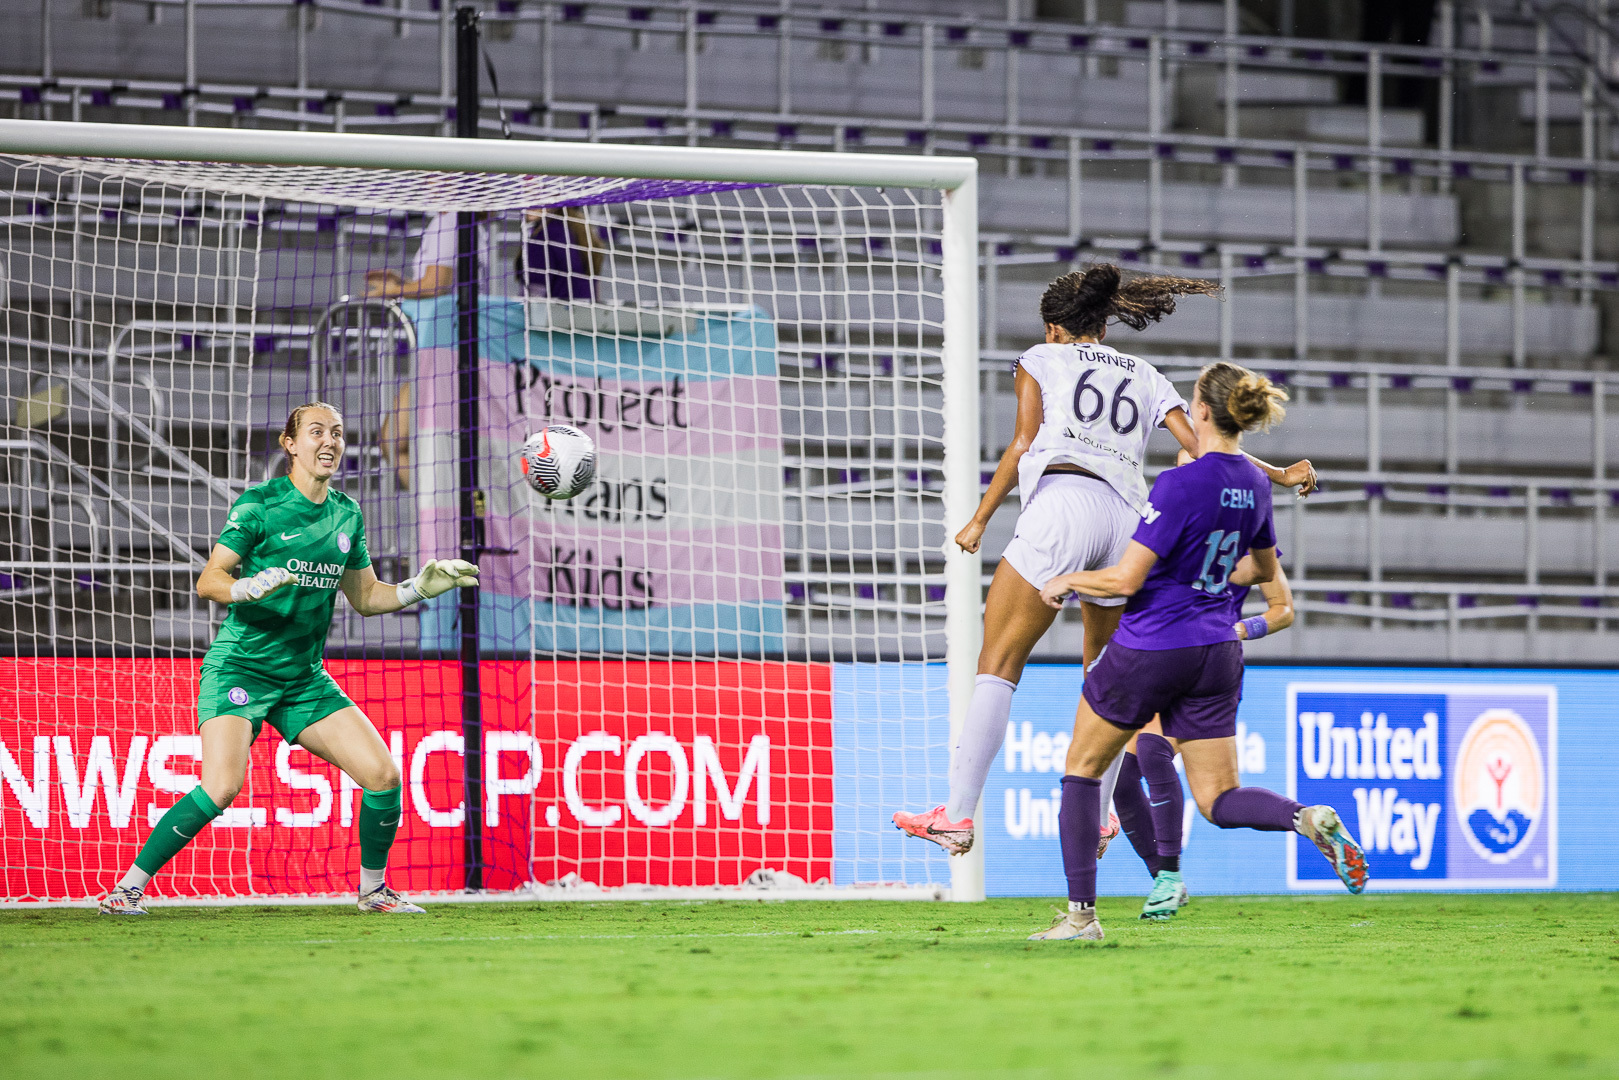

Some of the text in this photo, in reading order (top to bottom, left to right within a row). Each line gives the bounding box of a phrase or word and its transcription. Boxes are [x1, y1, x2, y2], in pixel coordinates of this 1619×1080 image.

[511, 358, 690, 431] Protect
[1076, 349, 1136, 373] TURNER
[1073, 367, 1139, 435] 66
[1220, 488, 1255, 509] CELIA
[286, 558, 345, 576] ORLANDO
[292, 573, 339, 589] HEALTH
[545, 544, 654, 611] Kids
[1191, 529, 1241, 594] 13
[1299, 711, 1442, 780] United
[0, 730, 771, 829] NWSSHOP.COM
[1353, 787, 1442, 871] Way
